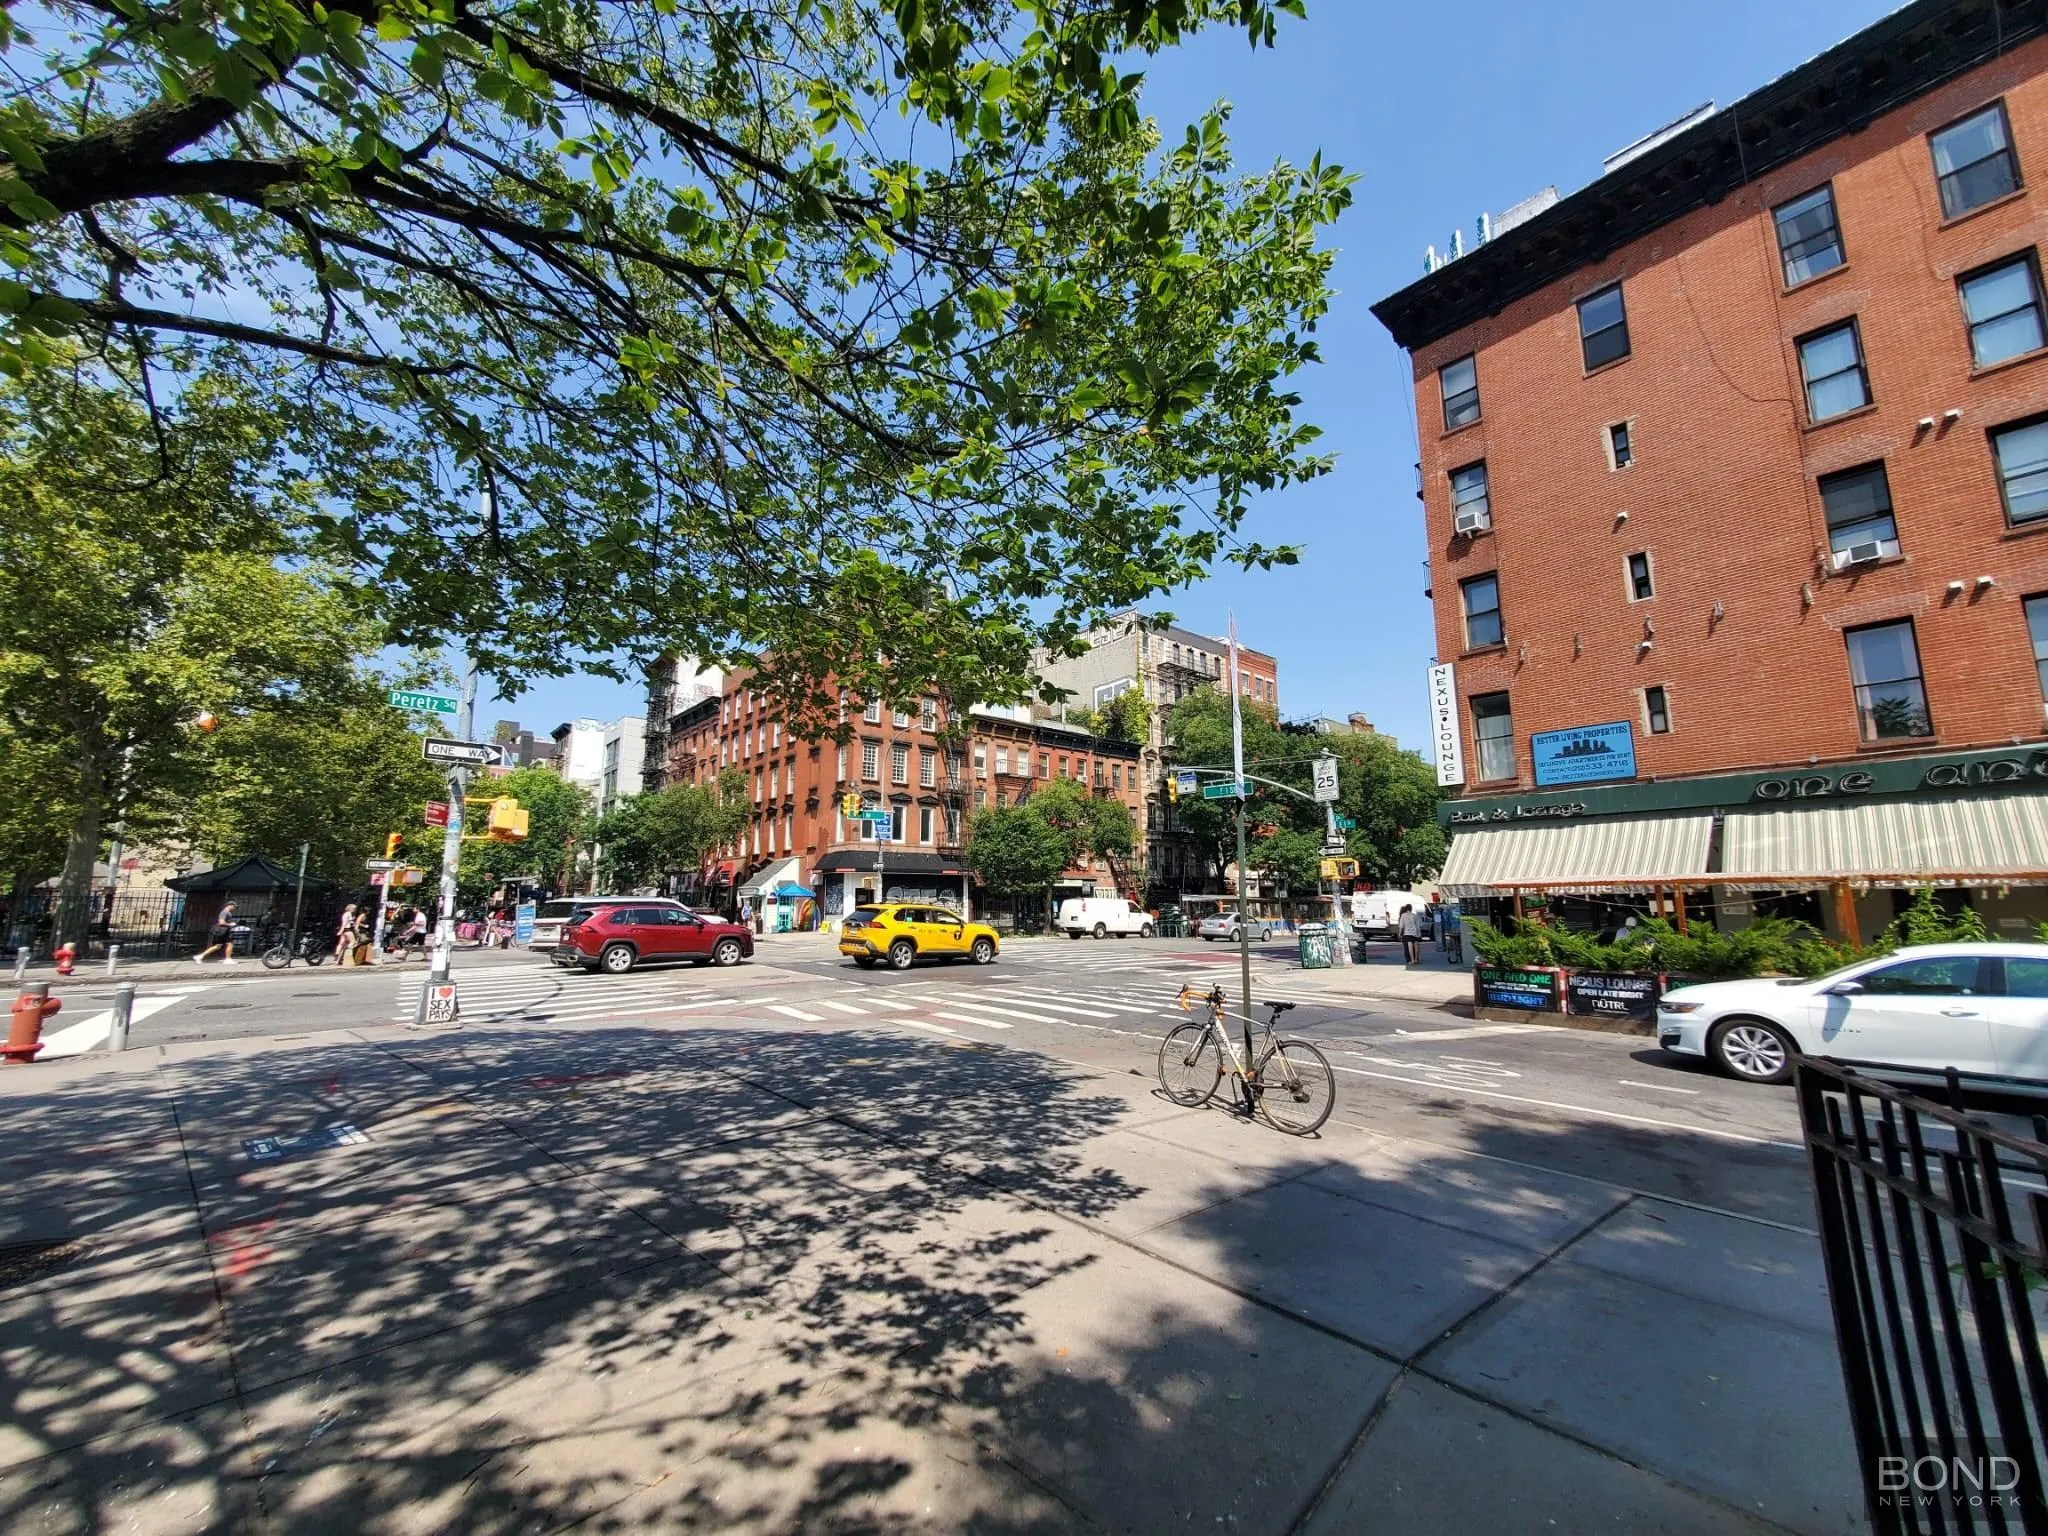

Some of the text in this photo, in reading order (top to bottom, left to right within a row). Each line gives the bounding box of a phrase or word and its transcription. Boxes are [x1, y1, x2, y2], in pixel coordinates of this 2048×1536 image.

[391, 692, 457, 710] Peretz Sq
[1536, 725, 1627, 745] BETTER LIVING PROPERTIES
[431, 744, 493, 760] ONE WAY
[1317, 775, 1335, 789] 25
[1755, 771, 1875, 800] one
[1450, 802, 1588, 823] Bar & Lounge
[1481, 970, 1502, 980] ONE
[1504, 972, 1527, 982] AND
[1529, 974, 1553, 985] ONE
[1568, 975, 1653, 991] NEXUS LOUNGE
[431, 988, 436, 999] I
[1512, 995, 1545, 1006] LIGHT
[1577, 988, 1645, 999] OPEN LATE NIGHT
[430, 999, 451, 1010] SEX
[428, 1010, 451, 1020] PAYS
